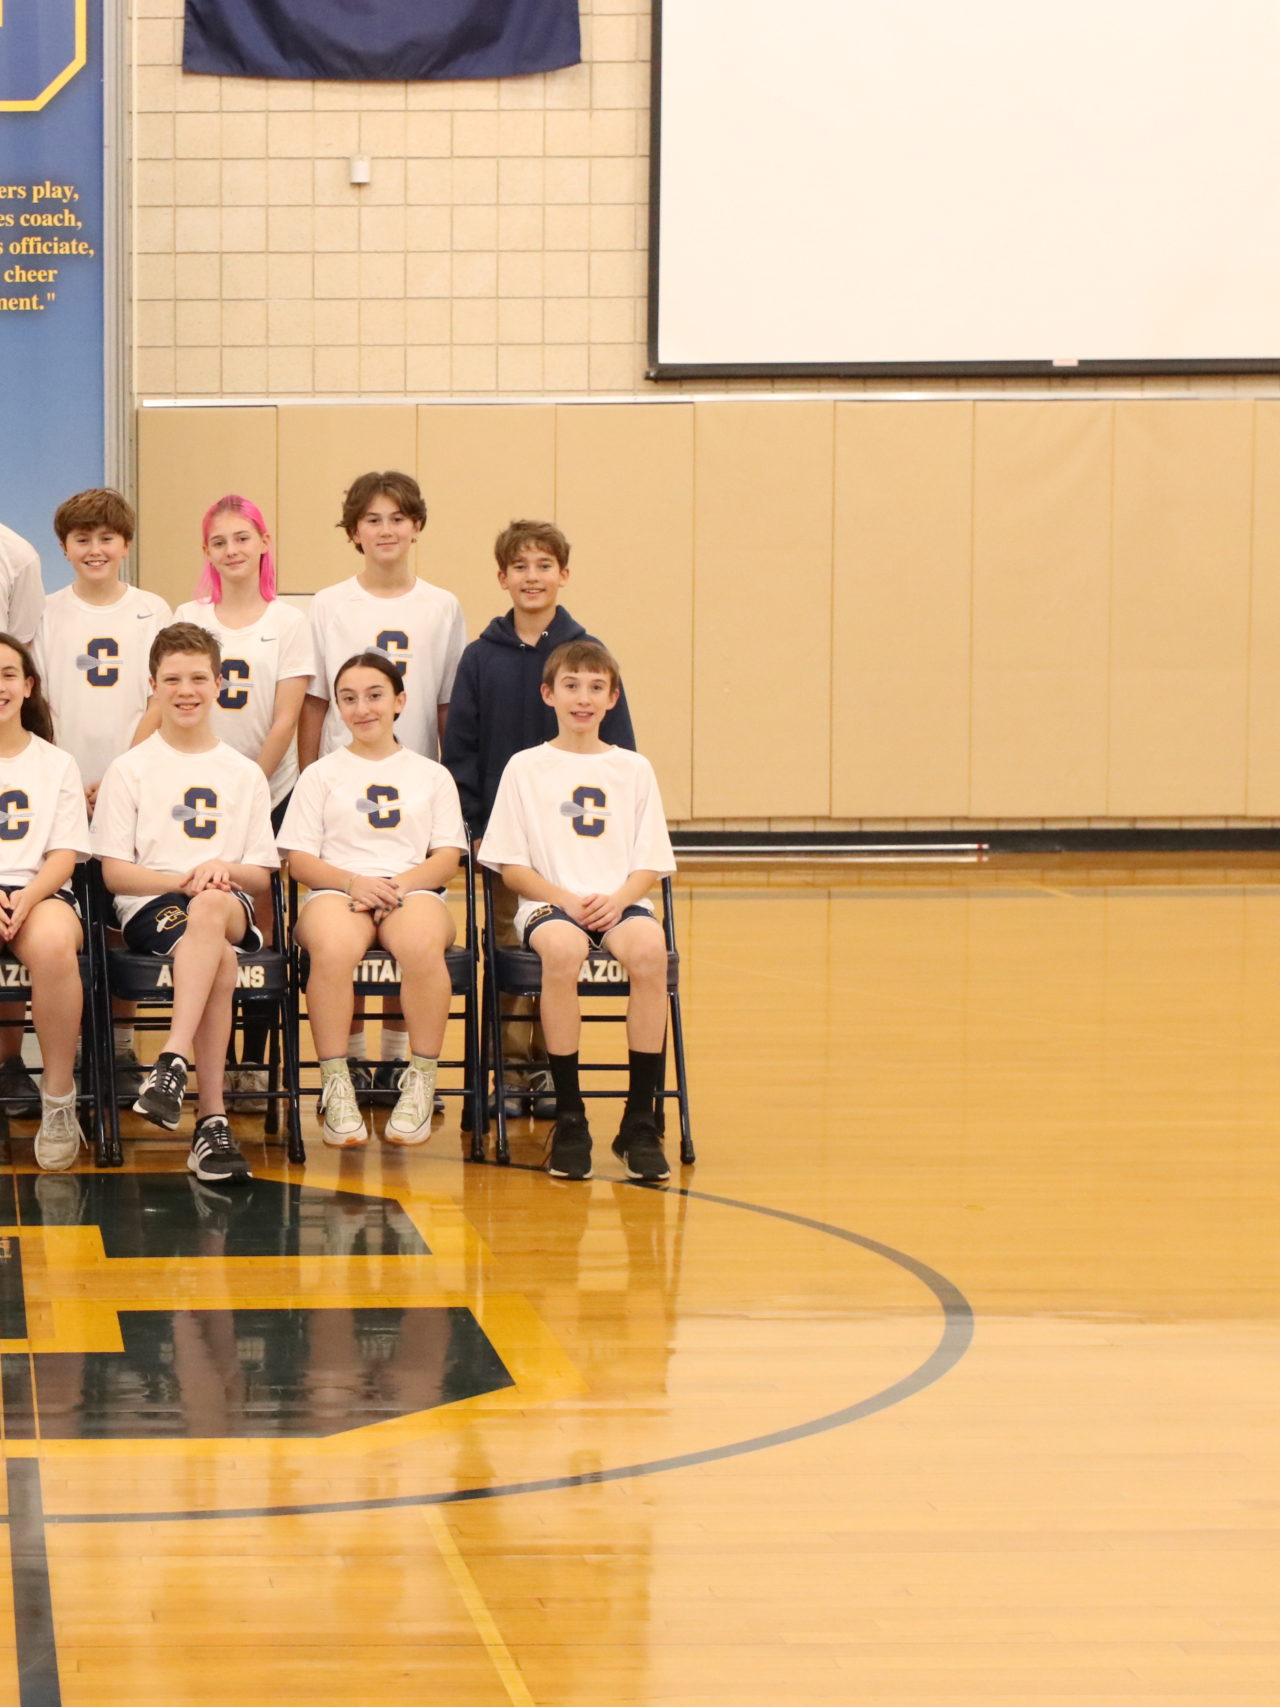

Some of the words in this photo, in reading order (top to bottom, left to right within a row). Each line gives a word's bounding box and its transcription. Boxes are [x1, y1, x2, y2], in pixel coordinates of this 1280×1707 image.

[32, 181, 80, 203] play,
[20, 209, 82, 229] coach,
[9, 237, 95, 258] officiate,
[4, 265, 58, 283] cheer
[86, 637, 119, 688] C
[217, 658, 250, 712] C
[183, 786, 219, 840] C
[365, 783, 401, 831] C
[572, 785, 606, 838] C
